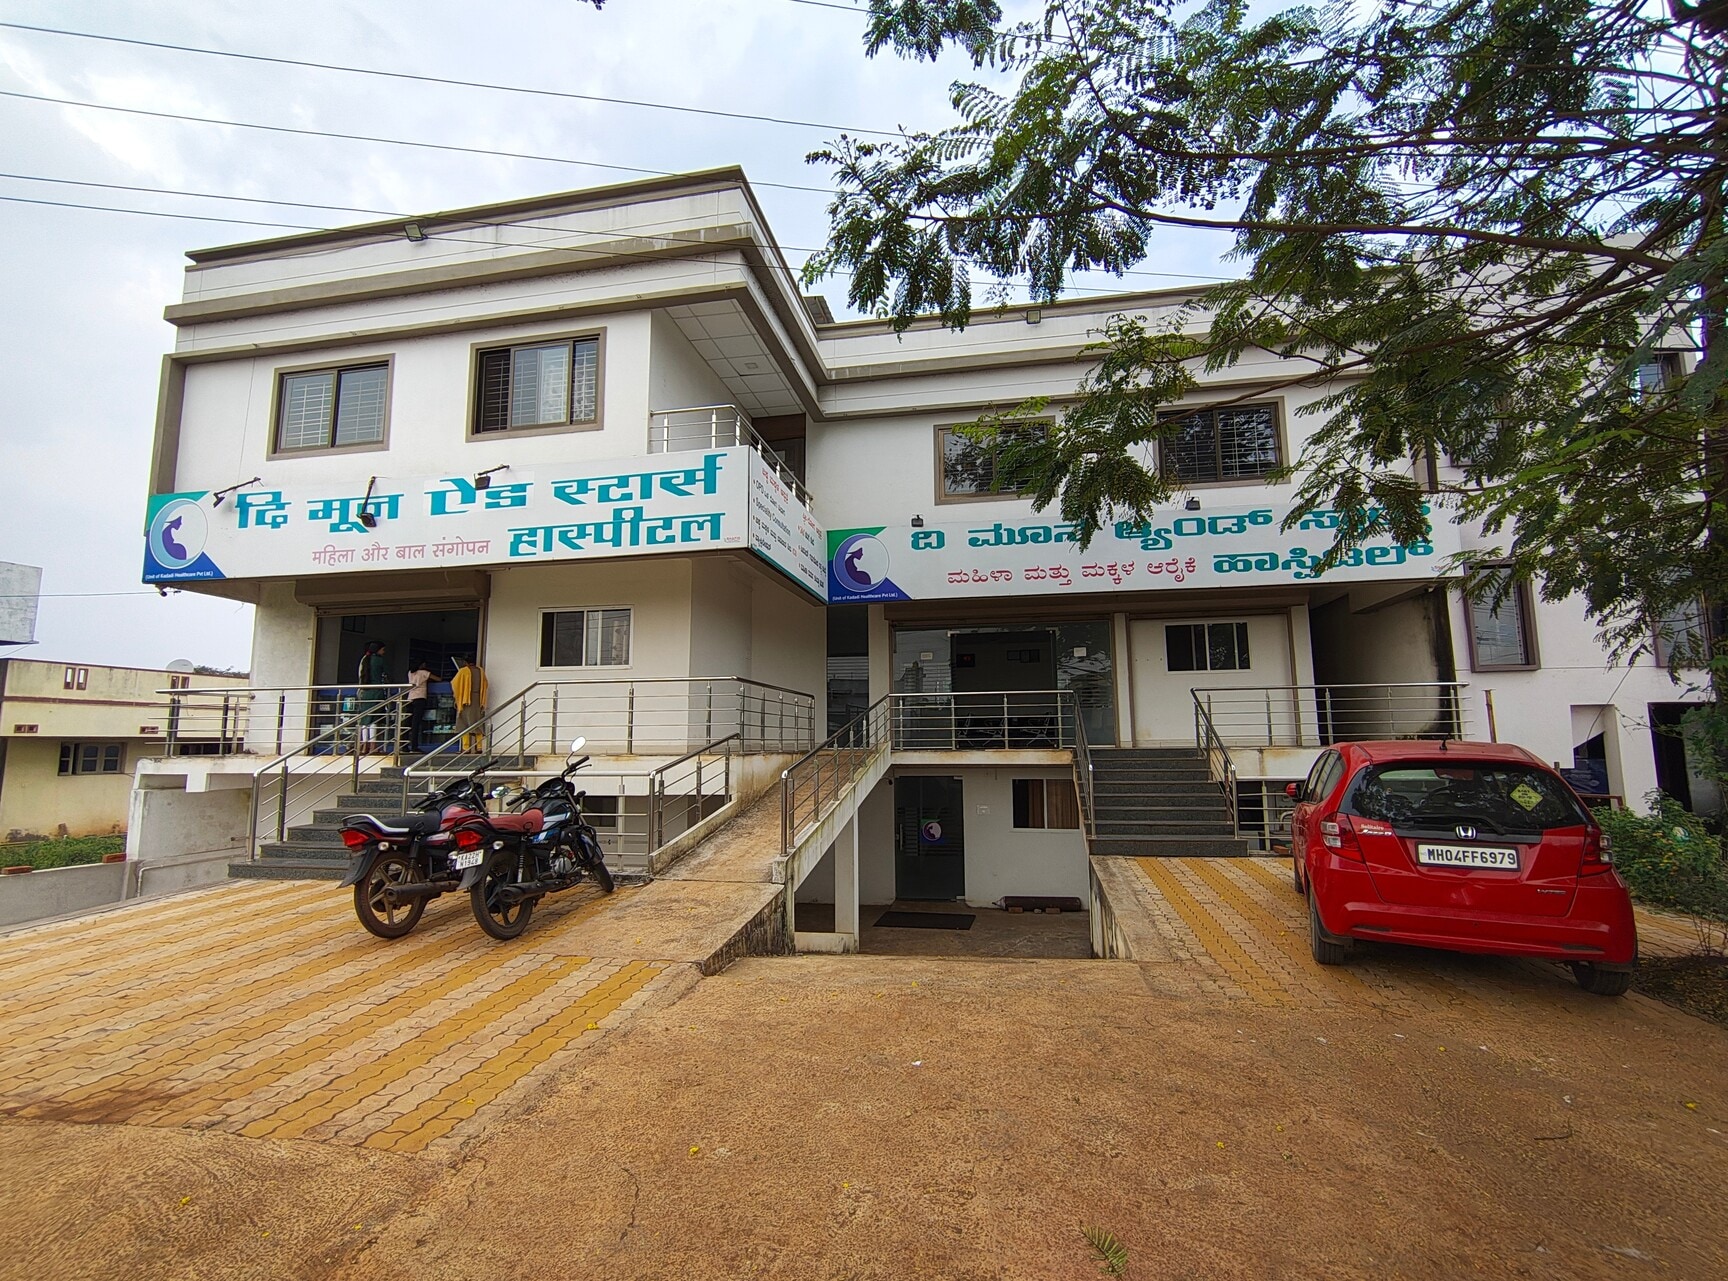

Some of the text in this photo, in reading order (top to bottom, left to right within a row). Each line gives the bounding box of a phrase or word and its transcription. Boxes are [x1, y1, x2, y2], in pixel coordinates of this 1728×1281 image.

[312, 536, 491, 566] महिला और बाल संगोपन
[947, 557, 1197, 586] ಮಹಿಳಾ ಮತ್ತು ಮಕ್ಕಳ ಆರೈಕೆ
[1427, 848, 1516, 865] MH04FF6979
